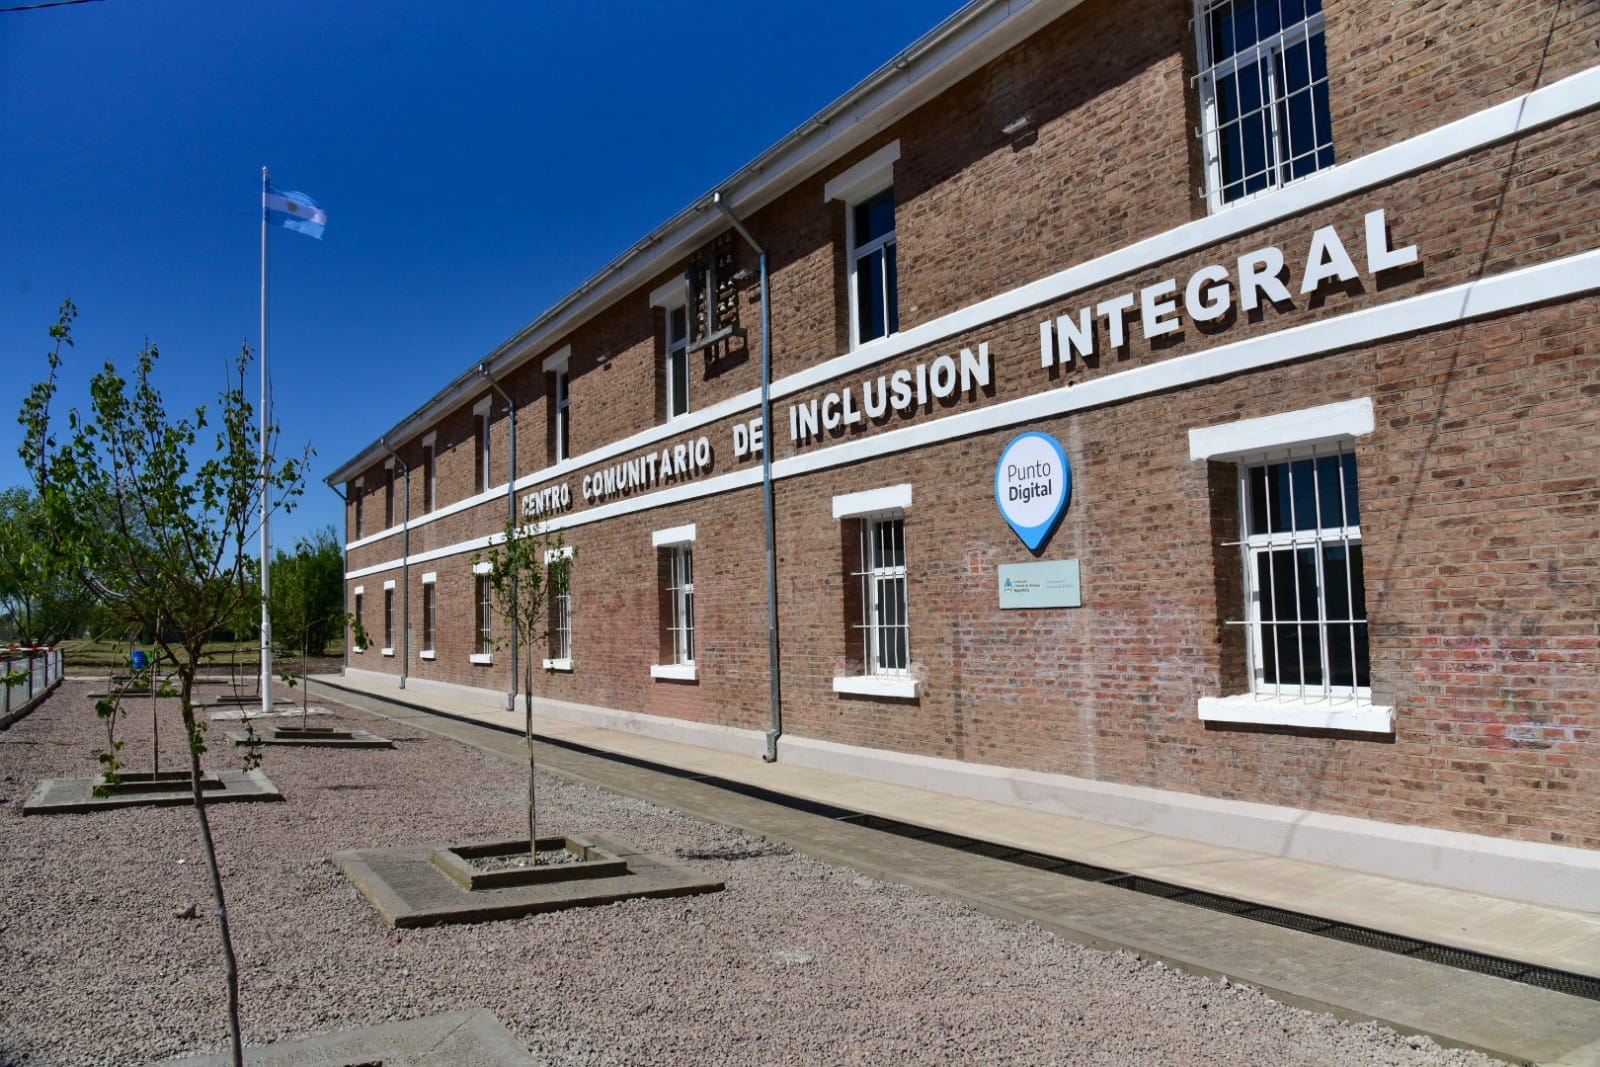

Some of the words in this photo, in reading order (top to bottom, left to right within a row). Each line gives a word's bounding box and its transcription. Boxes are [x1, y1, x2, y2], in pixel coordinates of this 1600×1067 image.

[521, 482, 570, 516] CENTRO
[582, 436, 710, 500] COMUNITARIO
[732, 416, 764, 457] DE
[789, 341, 990, 441] INCLUSION
[1040, 208, 1419, 369] INTEGRAL
[1007, 459, 1051, 482] Punto
[1008, 479, 1052, 503] Digital
